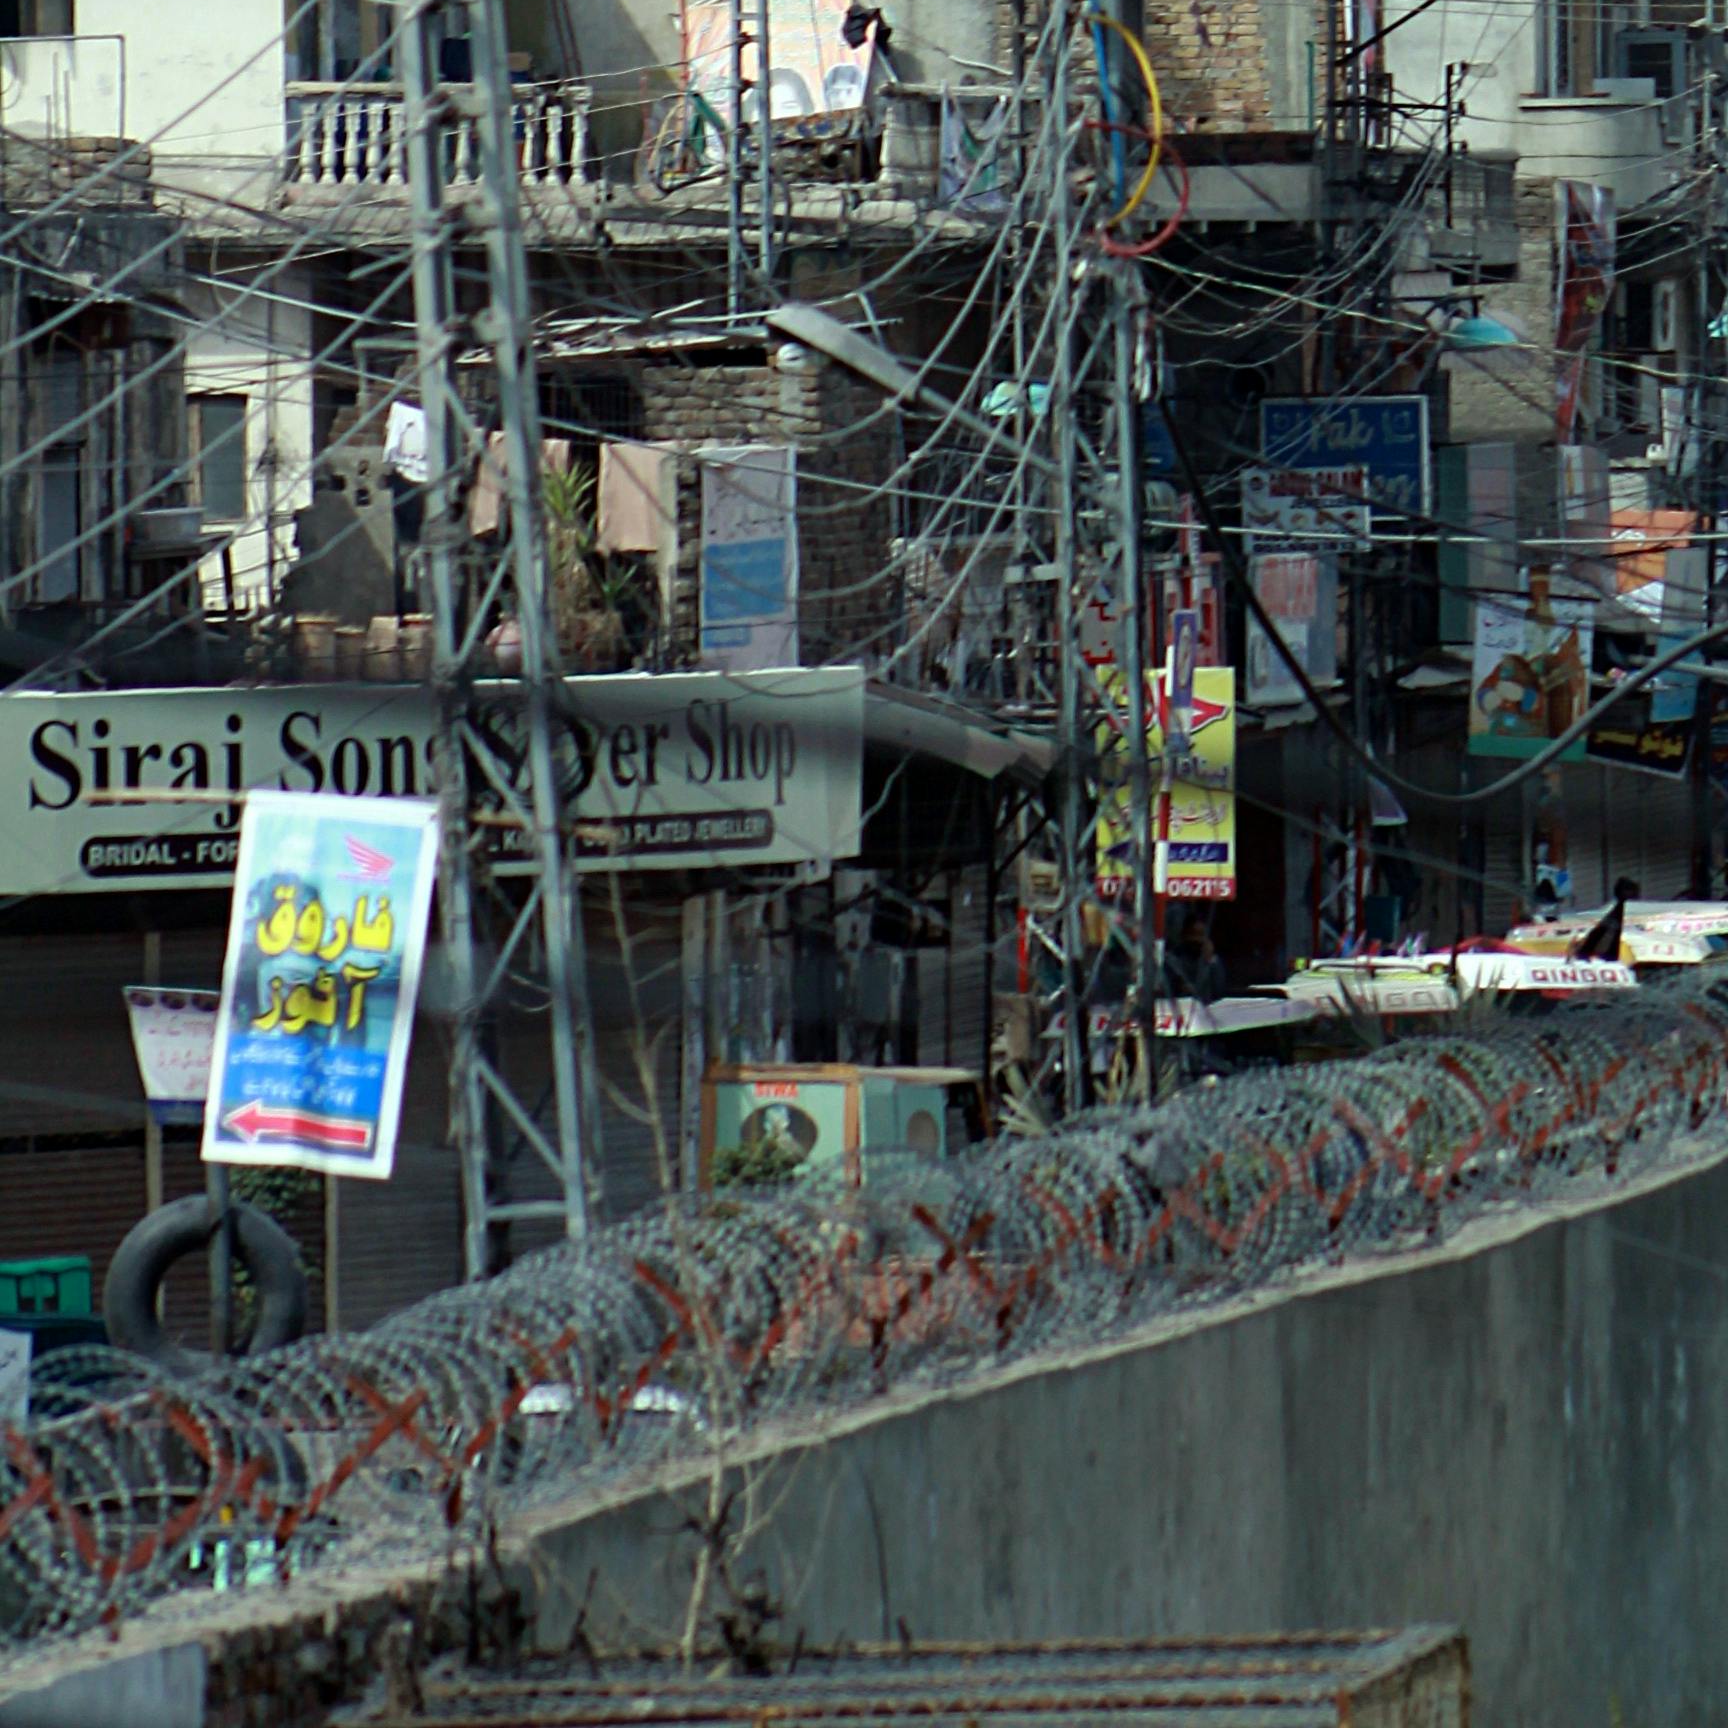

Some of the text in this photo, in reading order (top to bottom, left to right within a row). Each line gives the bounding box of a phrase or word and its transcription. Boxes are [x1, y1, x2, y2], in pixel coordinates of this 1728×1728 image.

[28, 714, 244, 829] Siraj
[686, 698, 797, 806] Shop
[88, 842, 176, 868] BRIDAL
[256, 884, 395, 961] فاروق
[250, 962, 381, 1035] آٹوز
